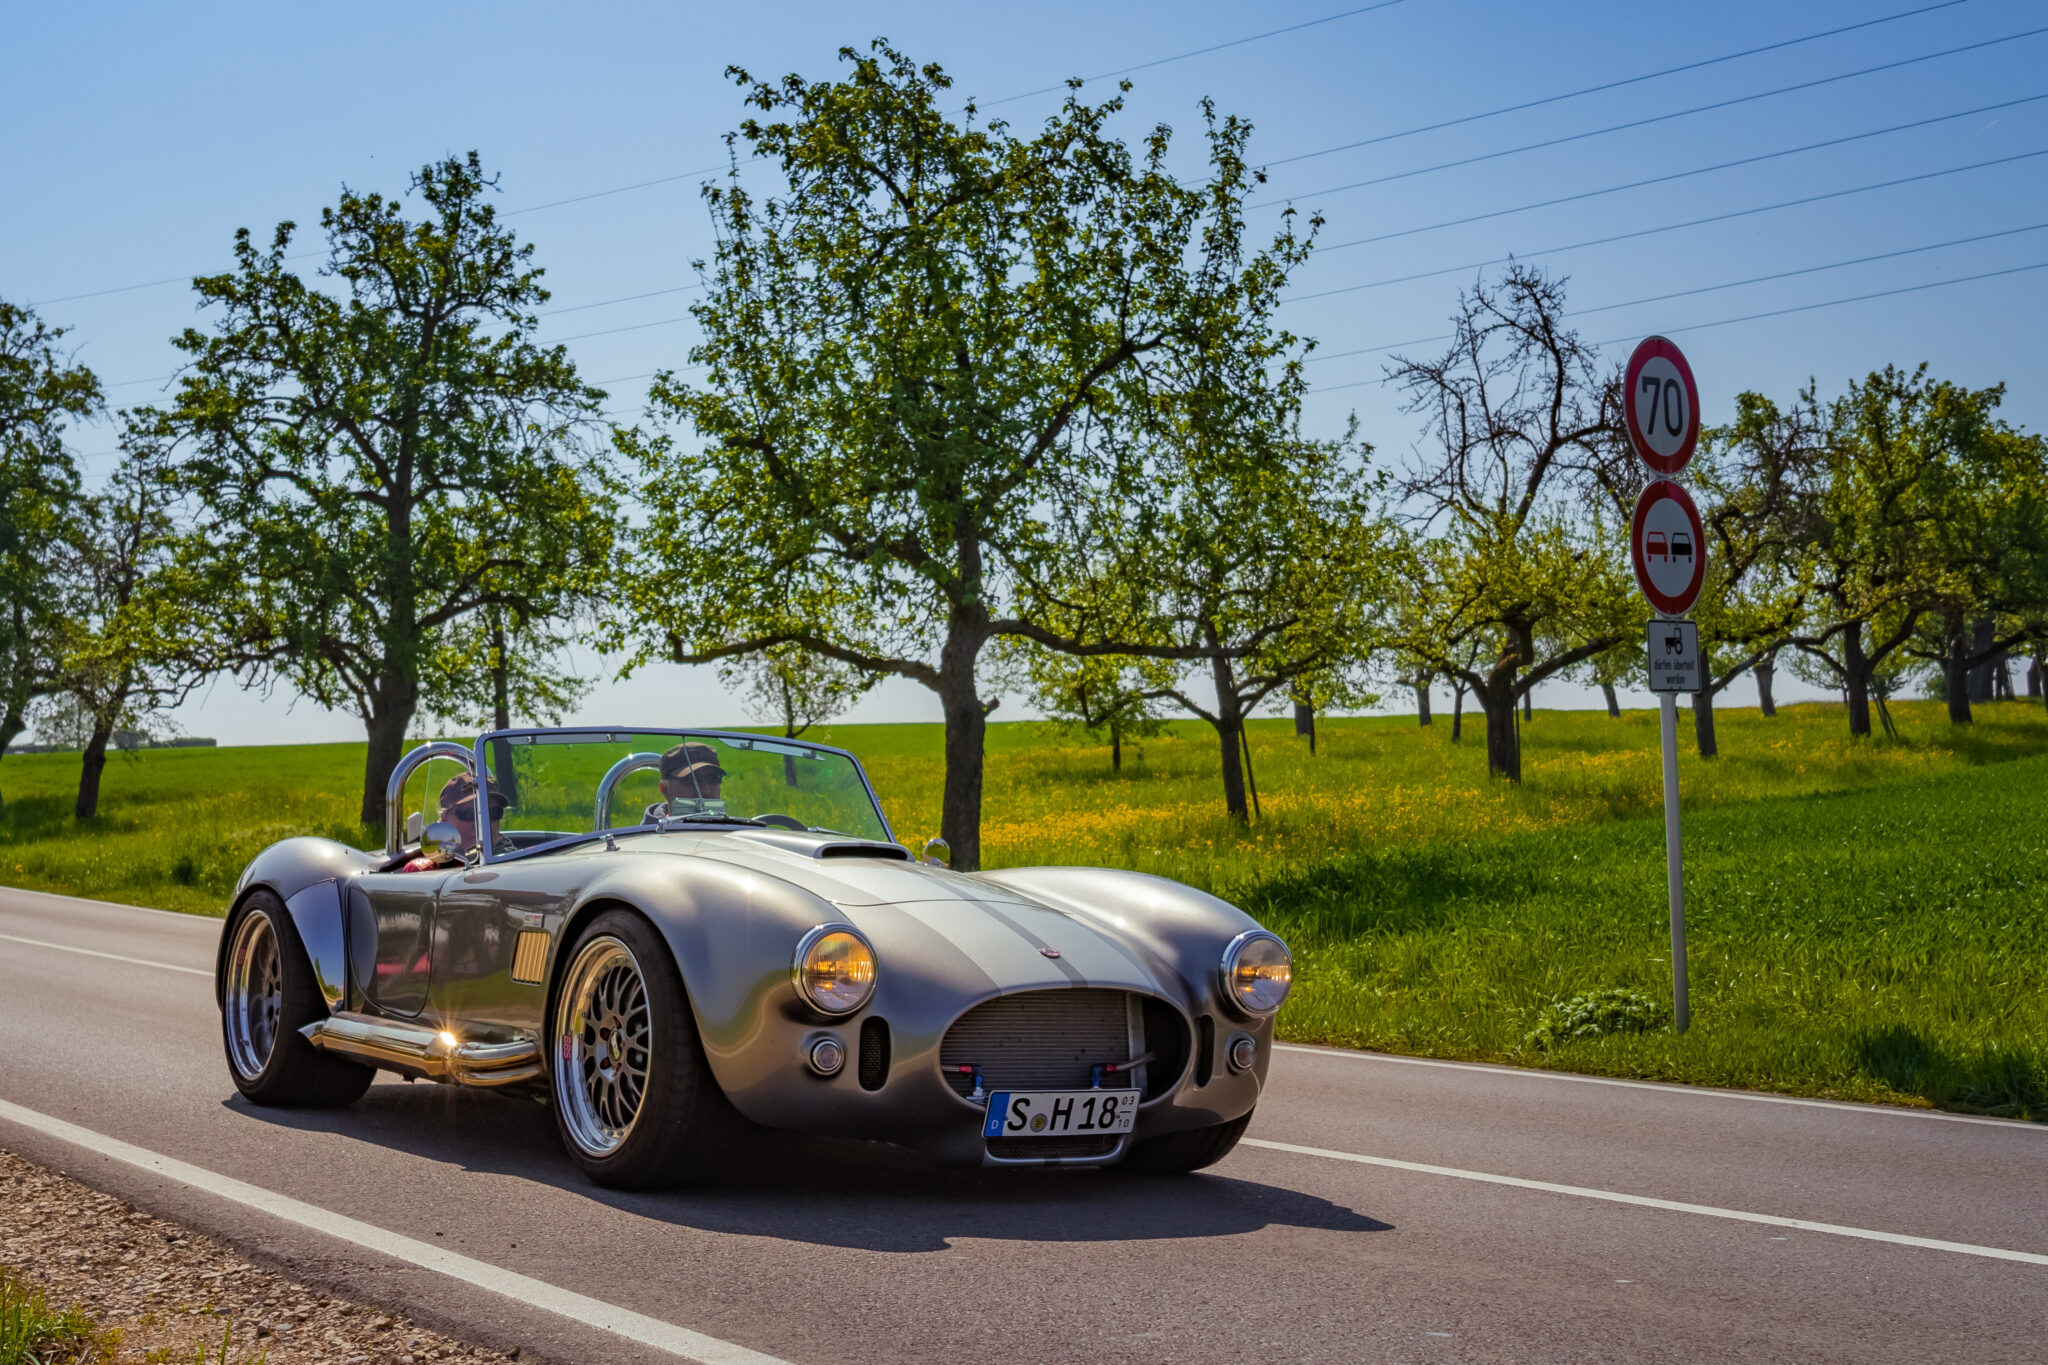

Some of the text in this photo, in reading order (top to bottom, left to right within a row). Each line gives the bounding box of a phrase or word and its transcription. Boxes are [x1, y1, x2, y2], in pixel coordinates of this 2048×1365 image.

[1641, 376, 1683, 437] 70
[1121, 1096, 1135, 1106] 03
[1007, 1097, 1031, 1131] S
[991, 1120, 999, 1129] D
[1118, 1118, 1130, 1128] 10
